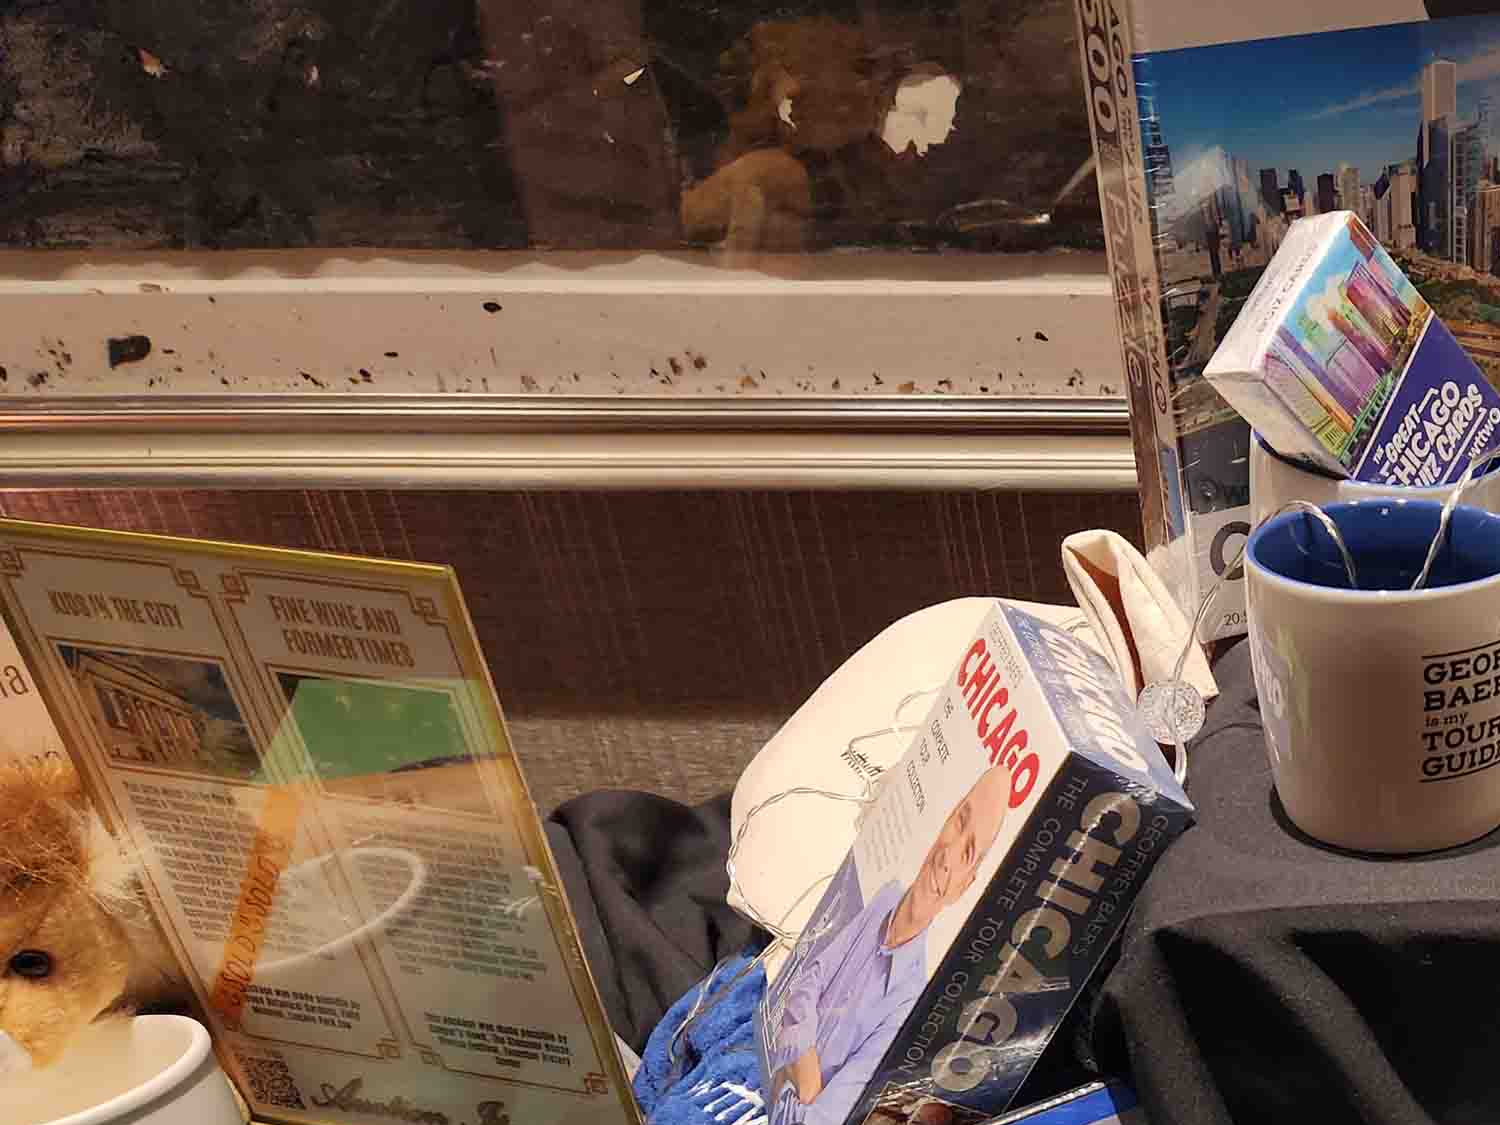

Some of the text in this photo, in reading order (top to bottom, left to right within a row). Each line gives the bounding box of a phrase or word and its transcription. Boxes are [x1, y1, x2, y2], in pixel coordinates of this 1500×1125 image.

[1385, 403, 1421, 463] GREAT
[1436, 383, 1483, 462] CARDS
[148, 604, 184, 630] CITY
[269, 594, 312, 625] FINE
[360, 607, 401, 635] AND
[282, 629, 354, 659] FORMER
[958, 638, 1041, 809] CHICAGO
[899, 774, 1089, 1075] THE COMPLETE TOUR COLLECTION
[930, 791, 1142, 1092] CHICAGO
